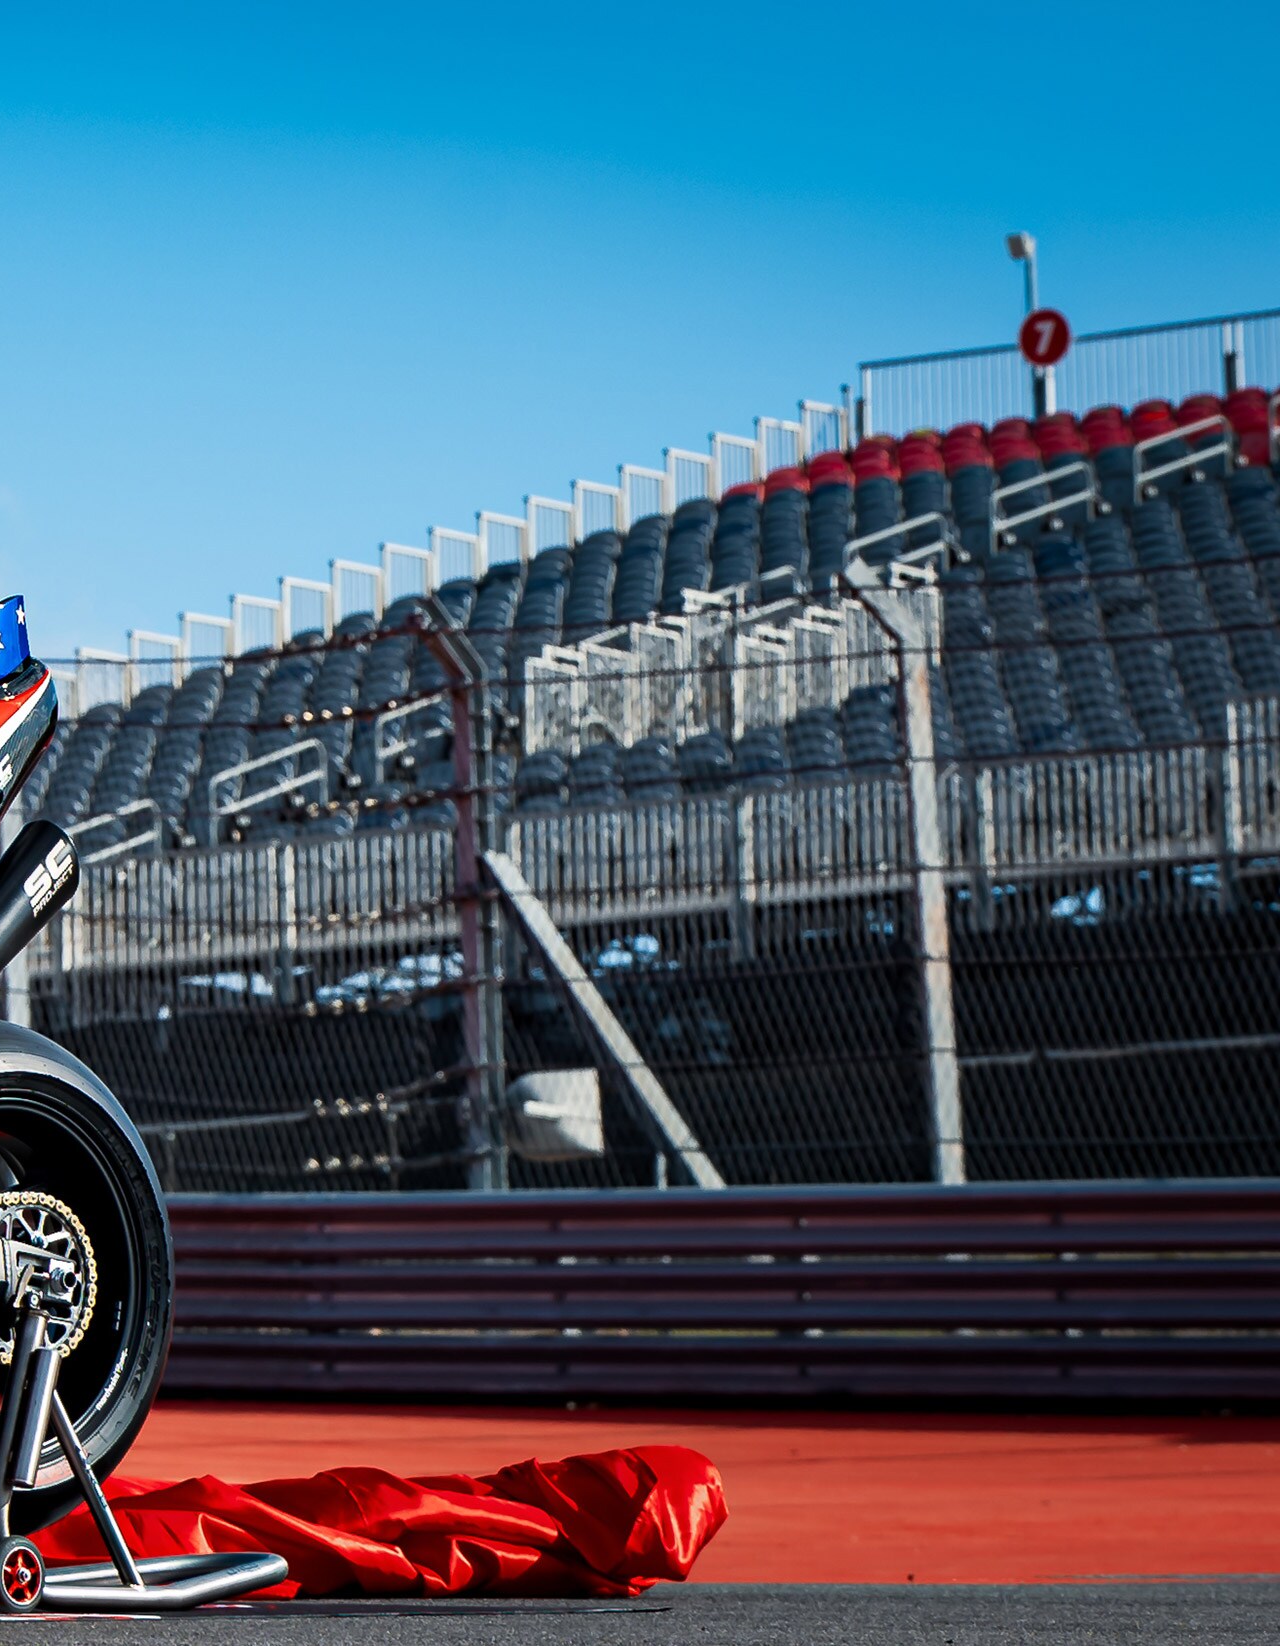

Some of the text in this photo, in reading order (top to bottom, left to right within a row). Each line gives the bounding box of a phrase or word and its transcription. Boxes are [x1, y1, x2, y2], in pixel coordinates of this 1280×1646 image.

[1034, 320, 1057, 355] 7
[23, 838, 74, 908] SC
[32, 863, 74, 918] PROJECT
